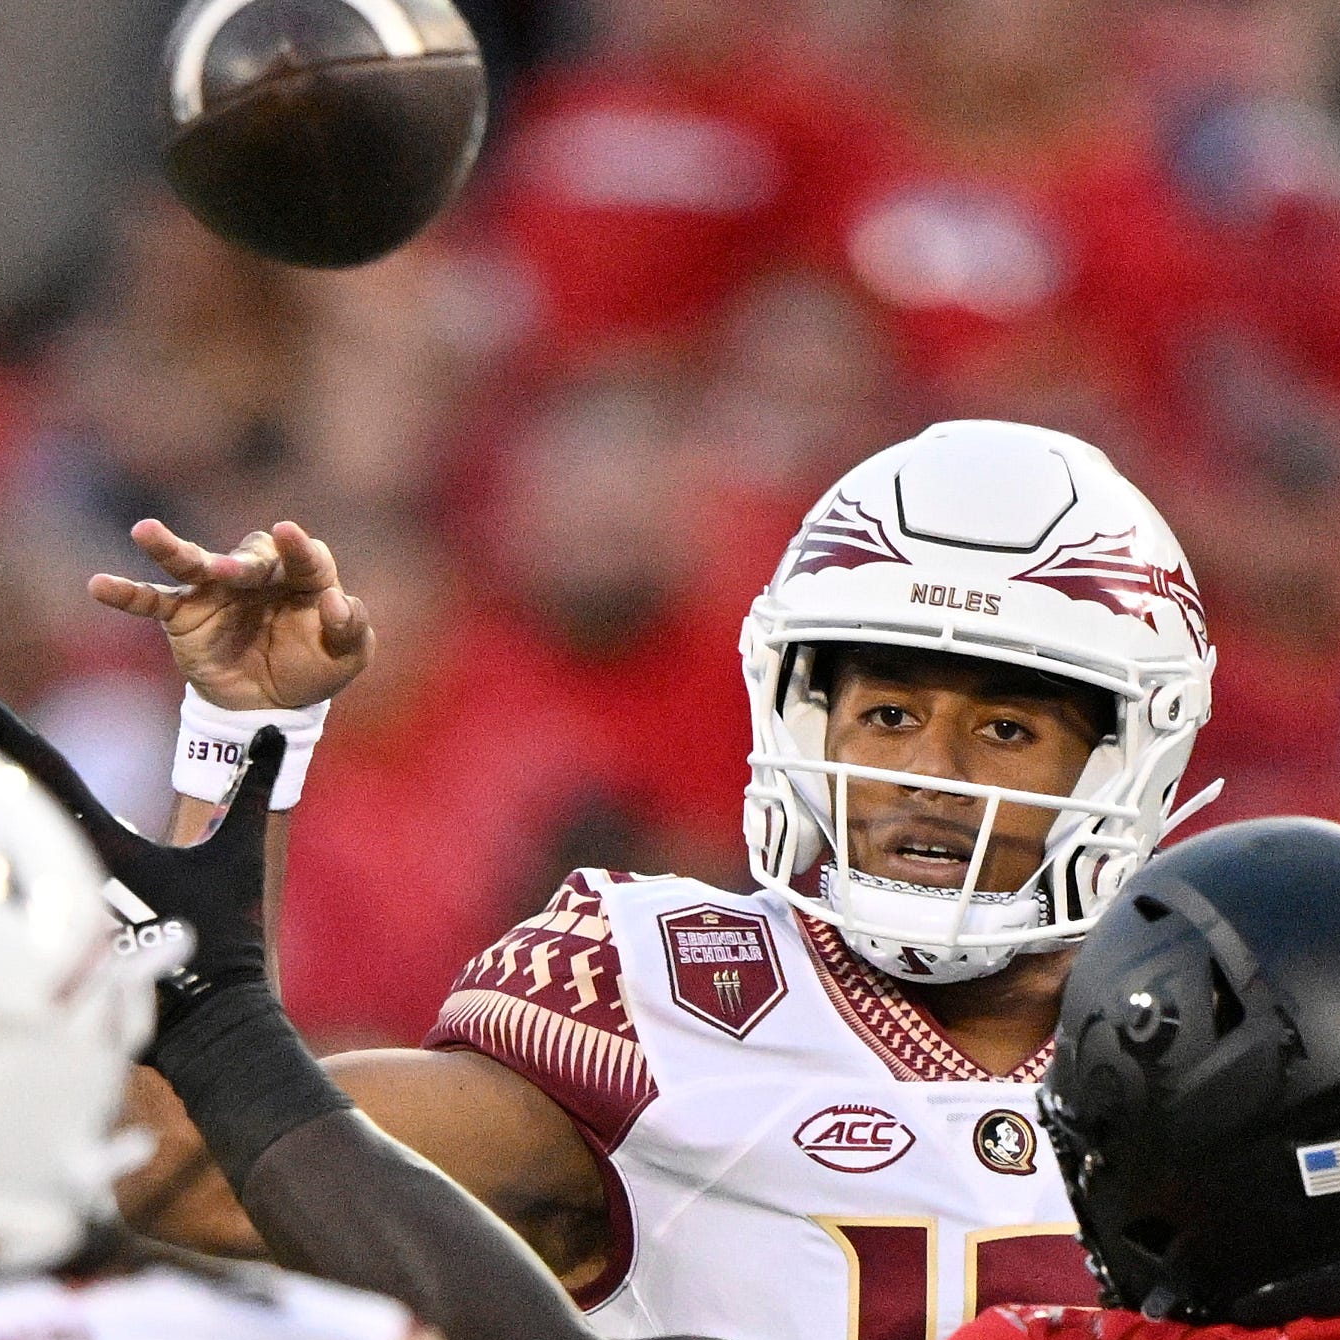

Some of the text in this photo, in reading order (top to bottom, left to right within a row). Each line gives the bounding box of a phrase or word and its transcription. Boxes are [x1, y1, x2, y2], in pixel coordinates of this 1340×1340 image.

[909, 582, 1002, 617] NOLES
[187, 739, 244, 766] OLES
[675, 930, 759, 947] SEMINOLE
[678, 945, 764, 964] SCHOLAR
[813, 1120, 898, 1147] ACC
